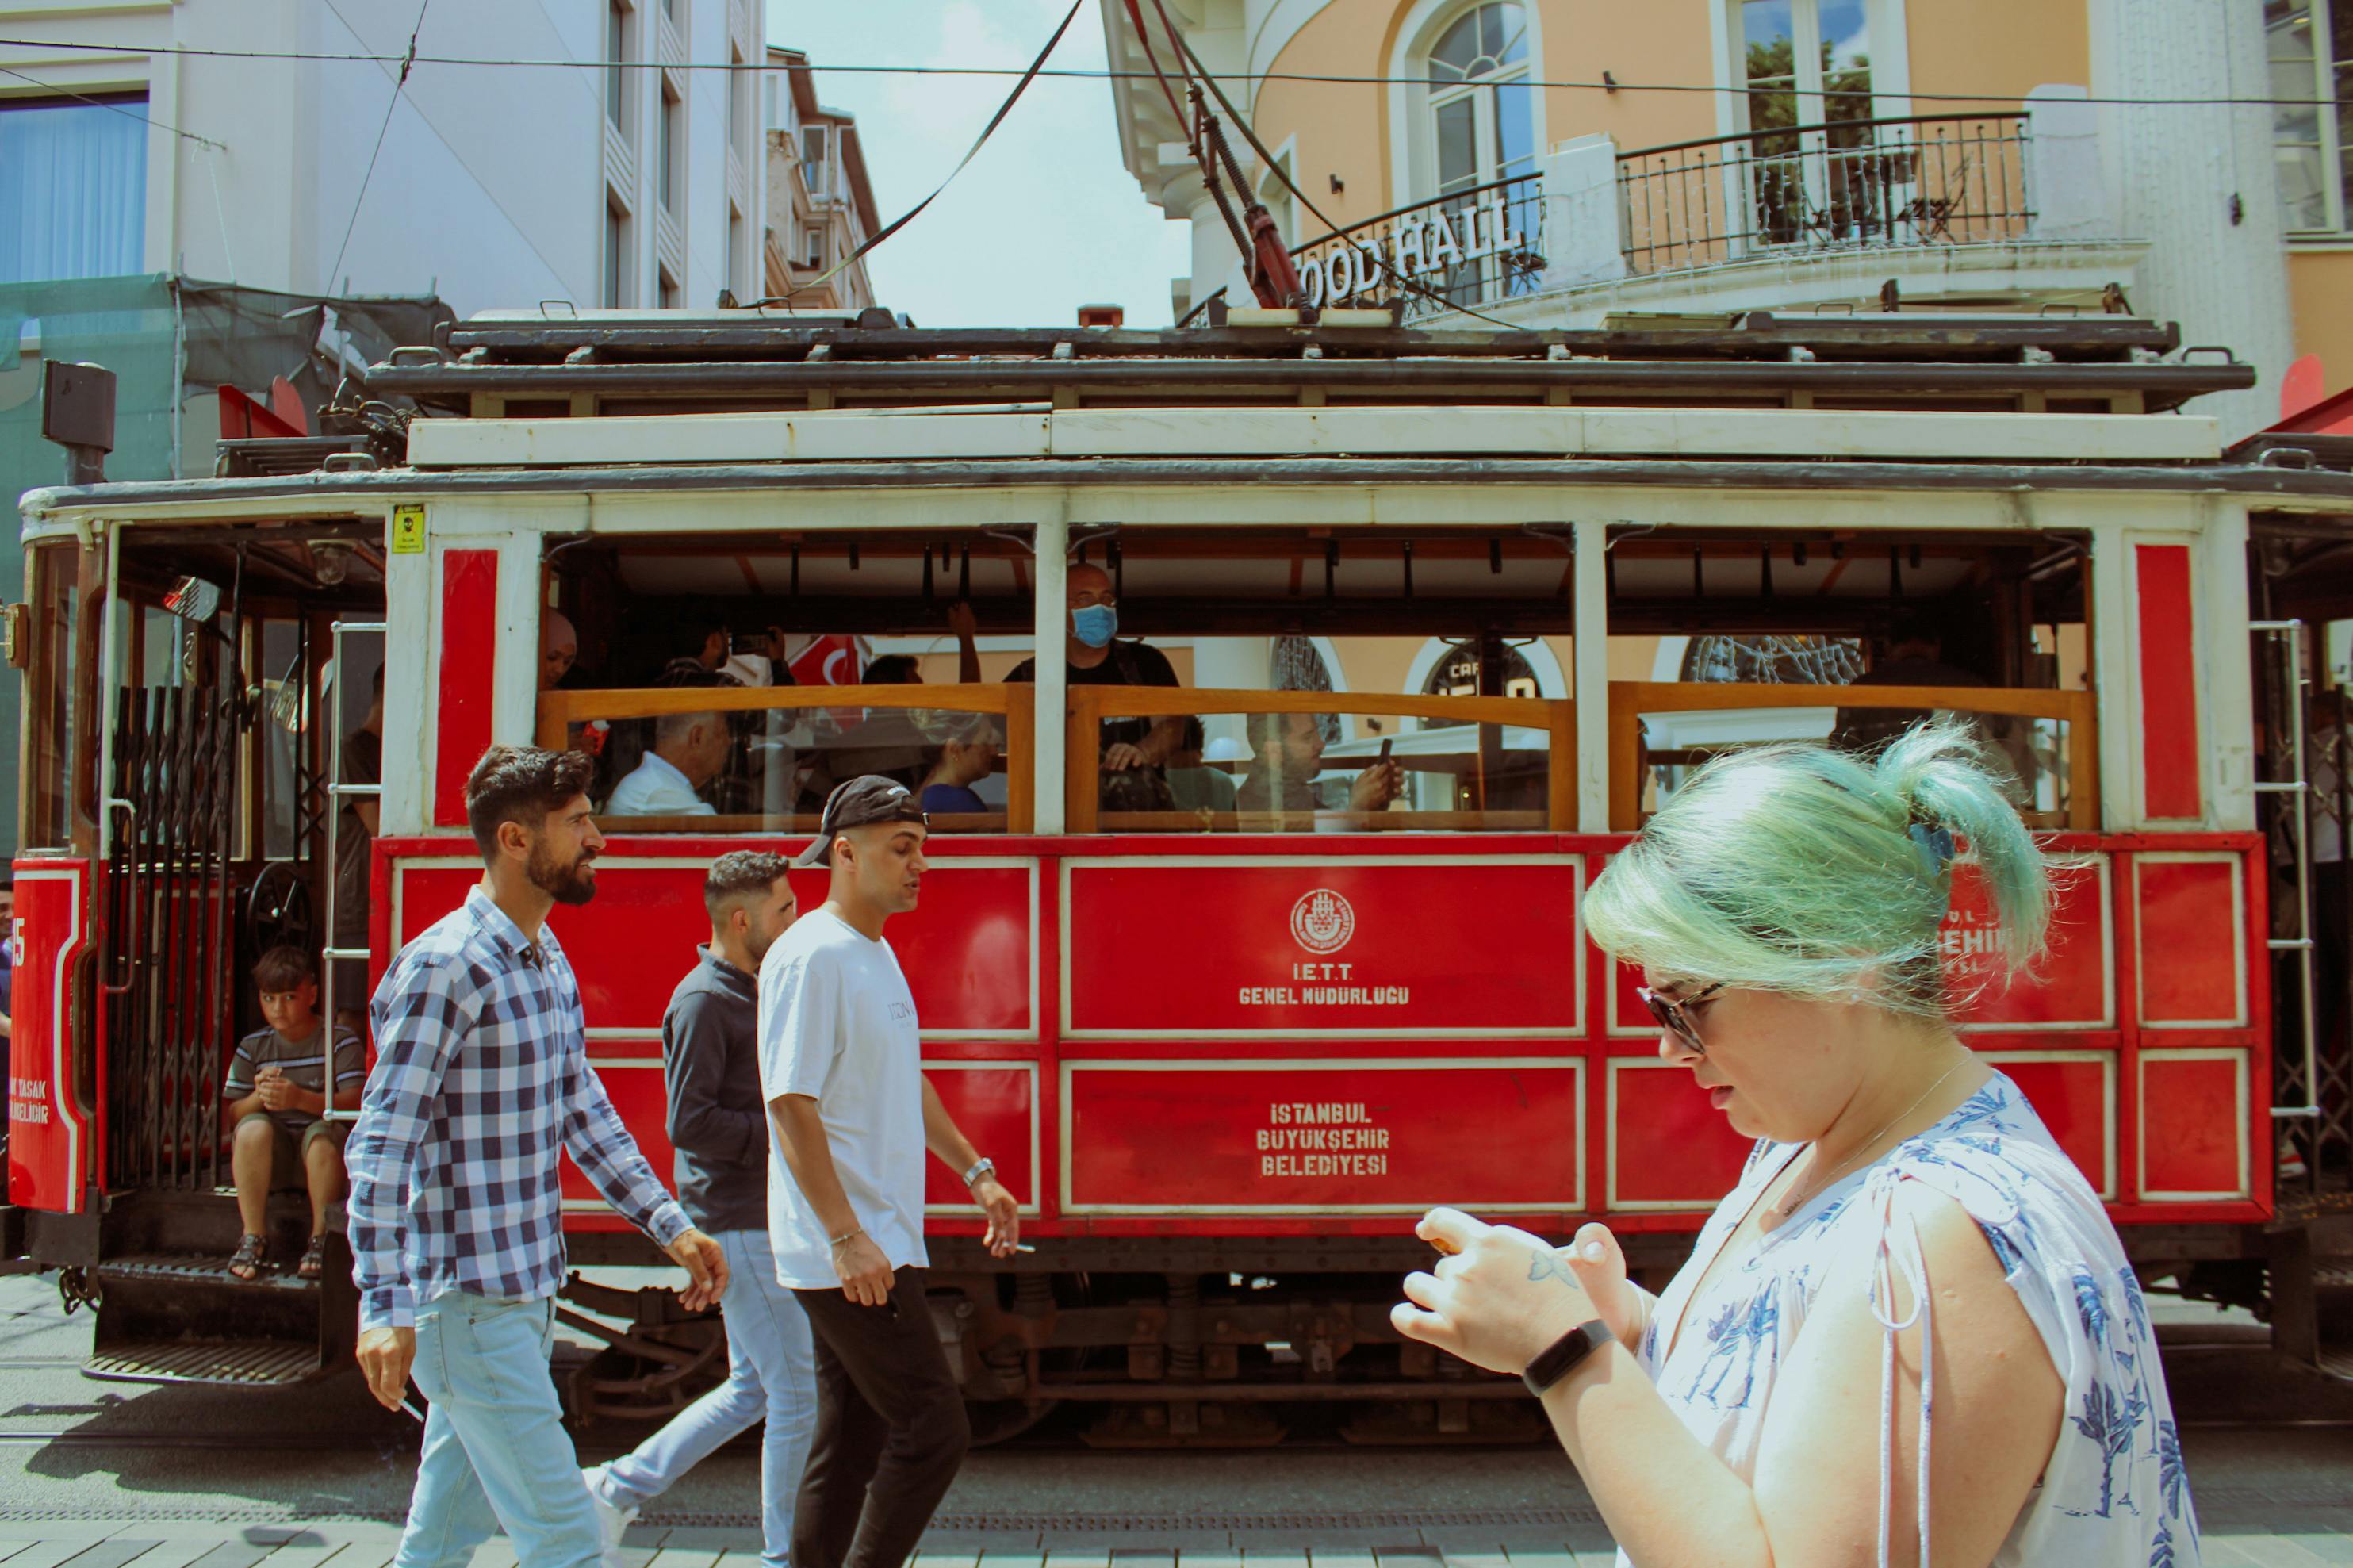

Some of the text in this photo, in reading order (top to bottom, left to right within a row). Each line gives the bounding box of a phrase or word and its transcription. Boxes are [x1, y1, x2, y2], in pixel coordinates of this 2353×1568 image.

[1293, 199, 1522, 309] OOD HALL
[1239, 986, 1409, 1005] GENEL MÜDÜRLÜĞÜ
[19, 1079, 46, 1099] YASAK
[1270, 1103, 1372, 1124] İSTANBUL
[1256, 1129, 1389, 1152] BÜYÜKŞEHİR
[1261, 1155, 1387, 1176] BELEDİYESİ
